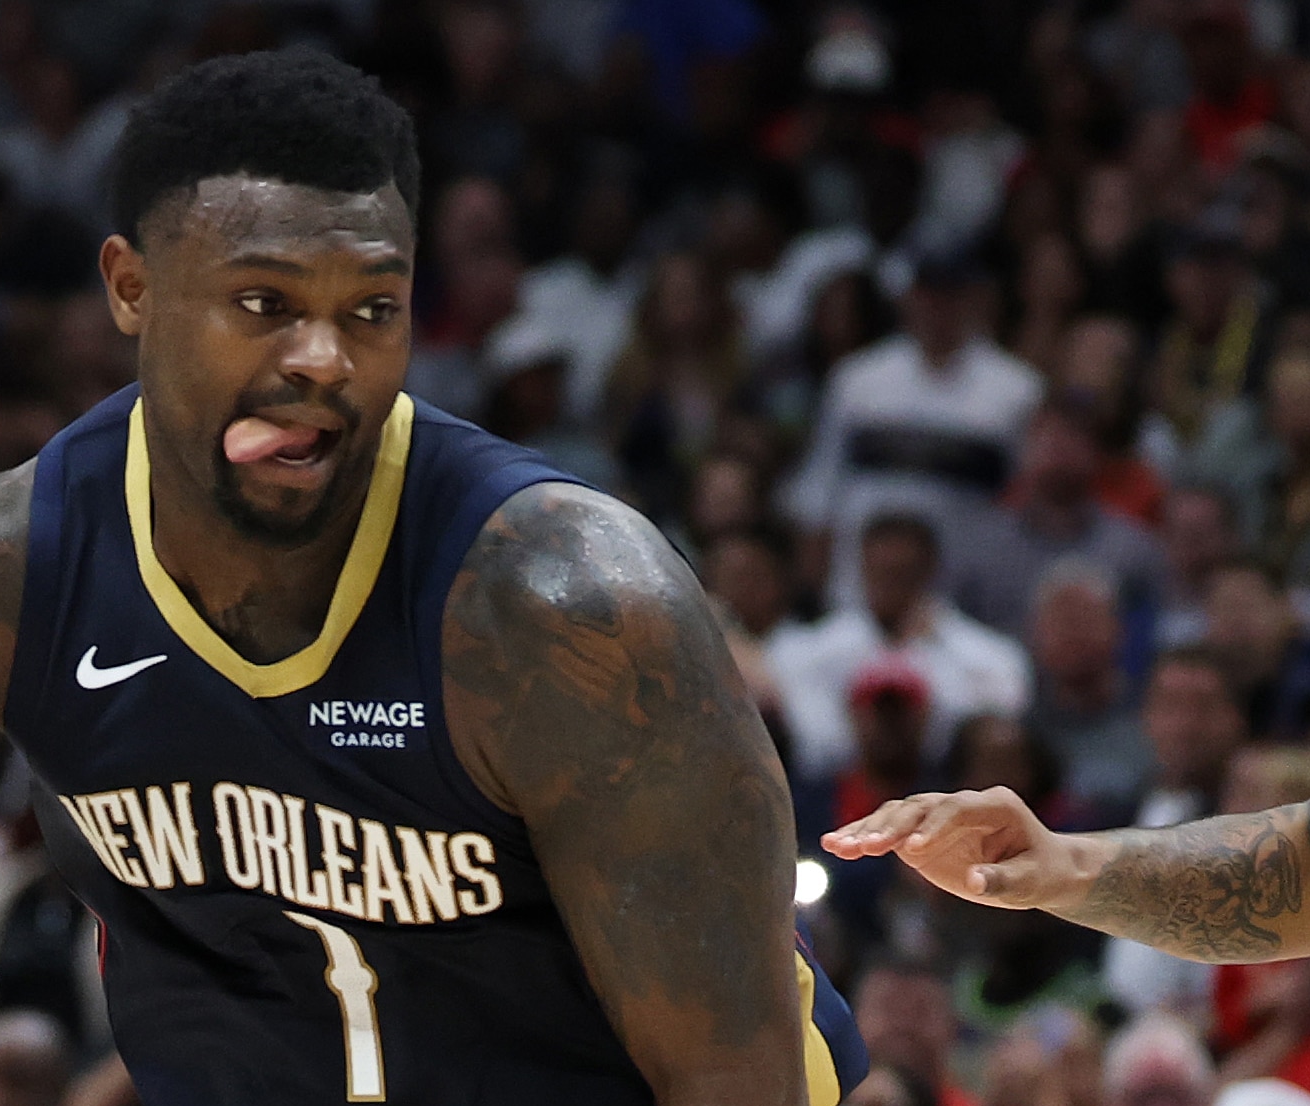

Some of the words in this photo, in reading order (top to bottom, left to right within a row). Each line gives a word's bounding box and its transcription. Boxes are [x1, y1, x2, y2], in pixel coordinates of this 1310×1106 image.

[309, 701, 425, 728] NEWAGE
[330, 731, 406, 748] GARAGE
[57, 782, 205, 890] NEW
[215, 781, 503, 925] ORLEANS
[281, 910, 387, 1102] 1
